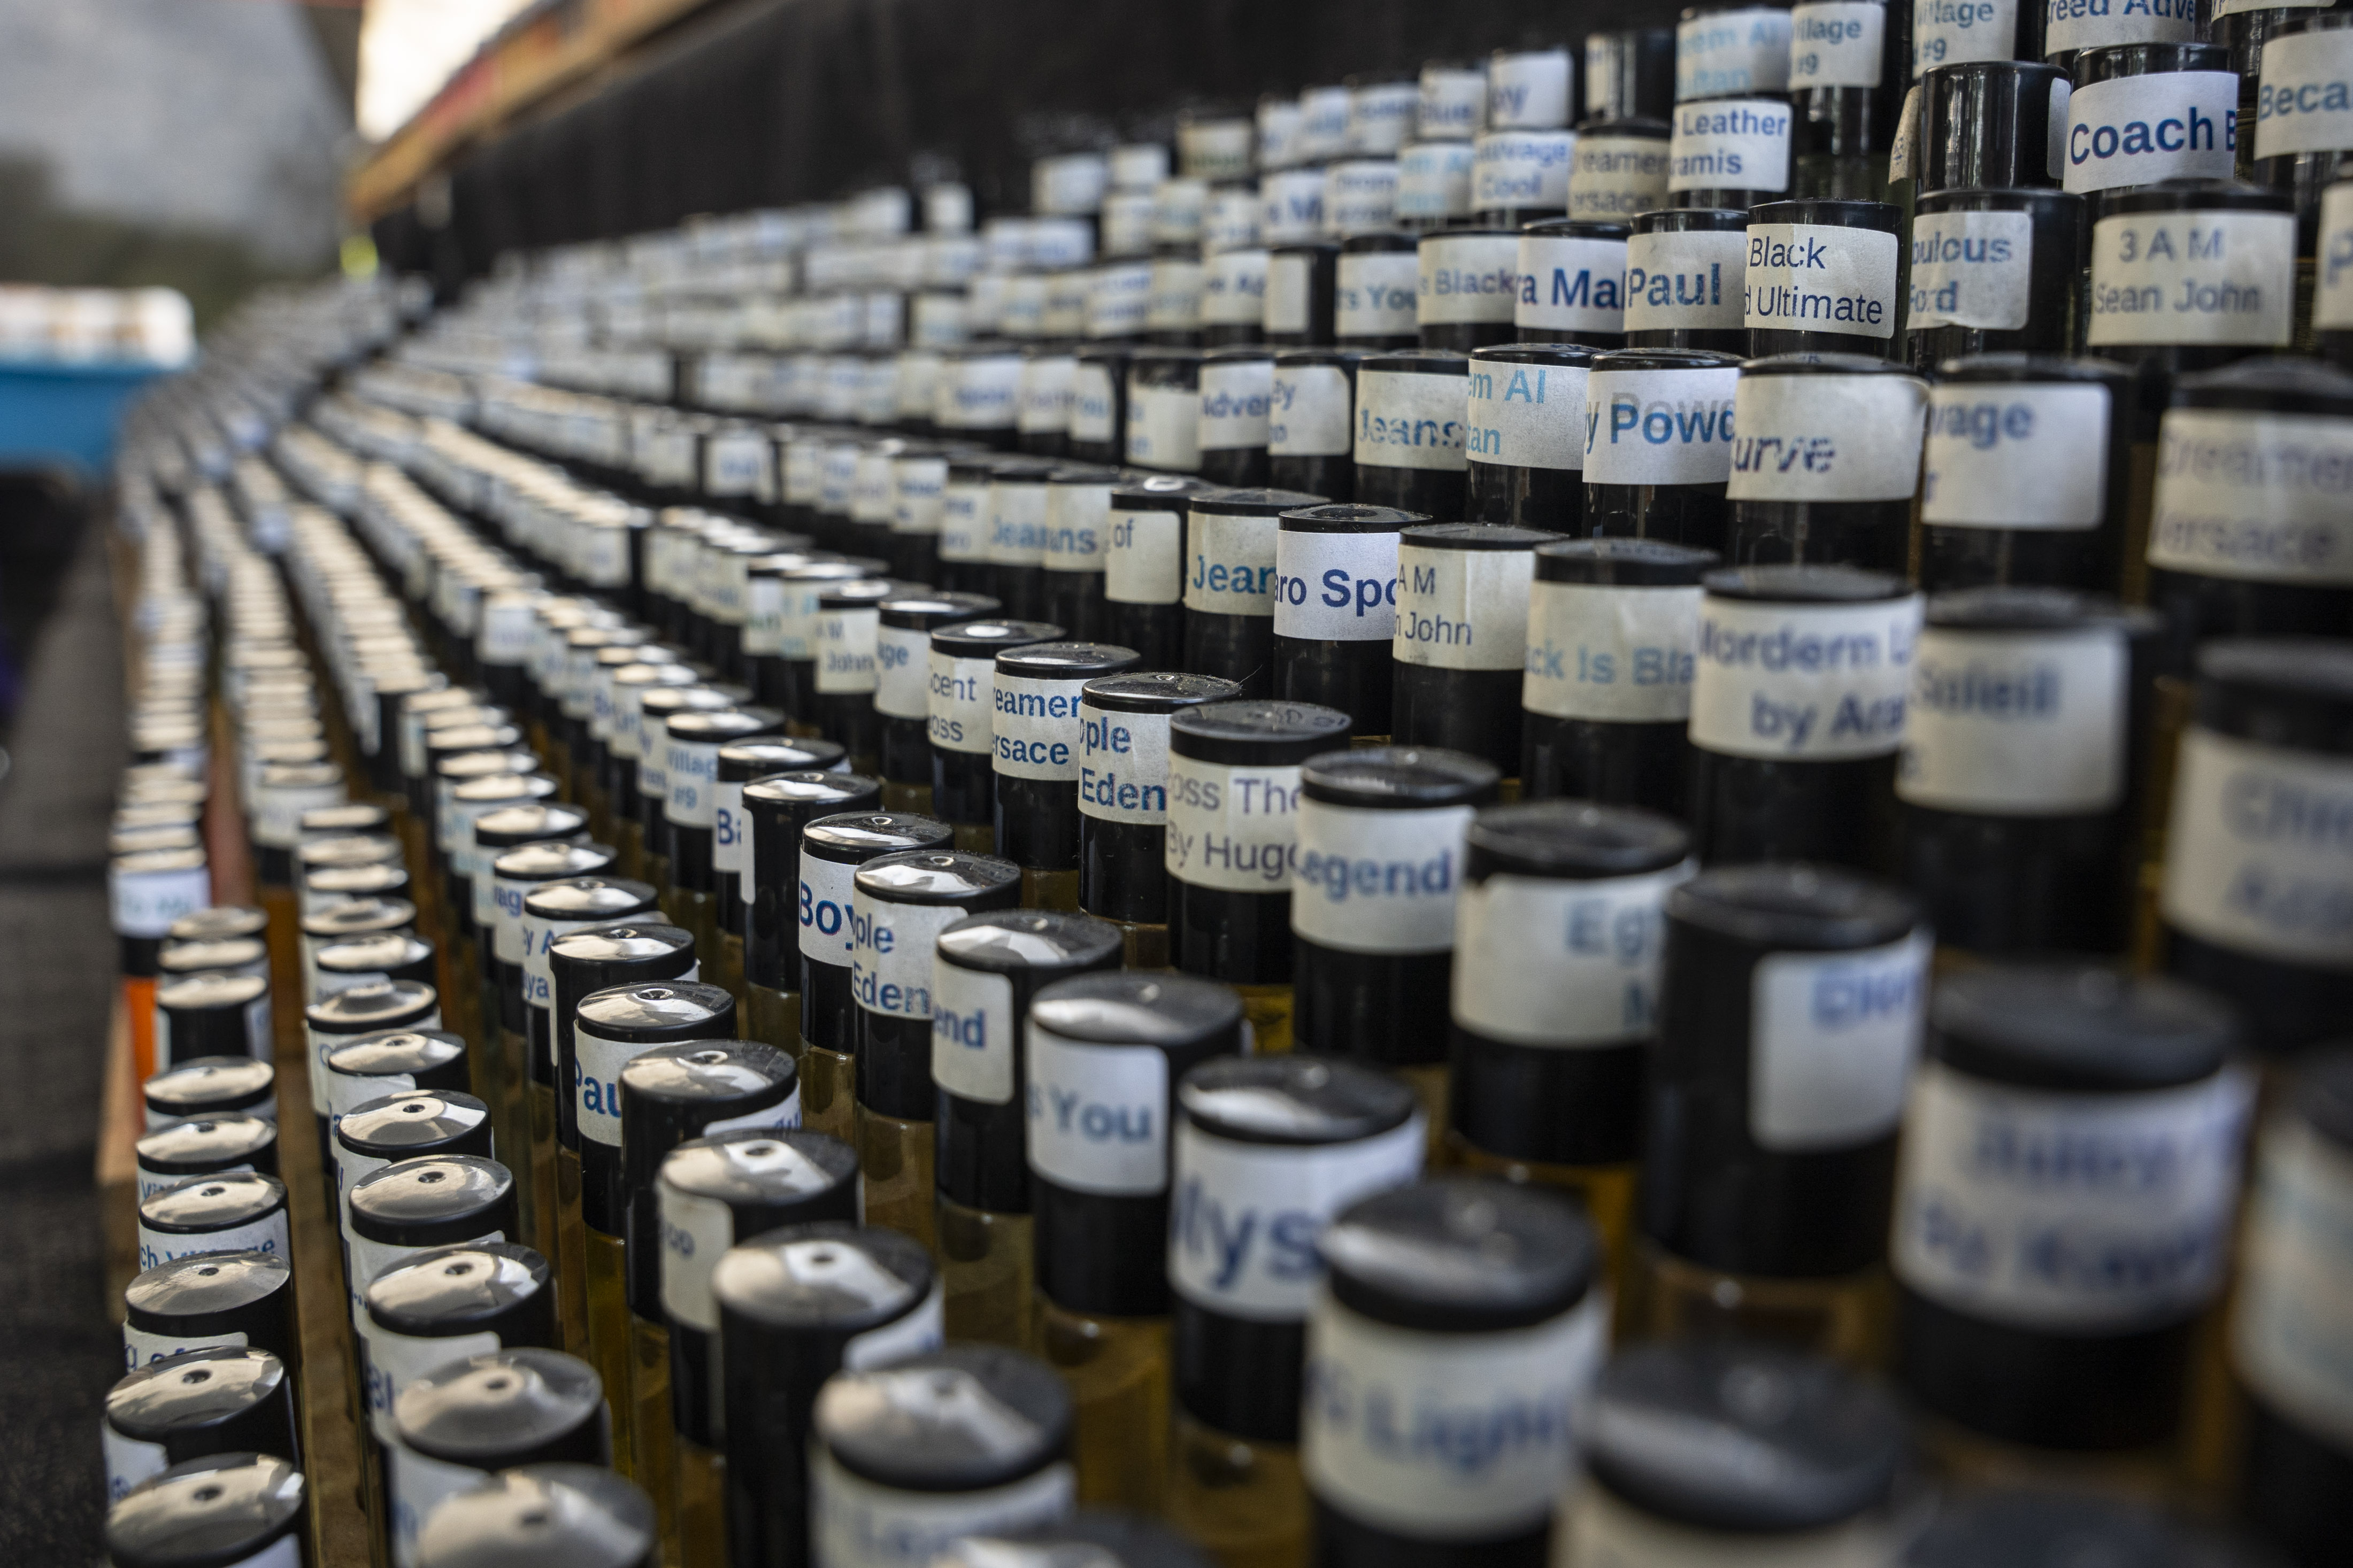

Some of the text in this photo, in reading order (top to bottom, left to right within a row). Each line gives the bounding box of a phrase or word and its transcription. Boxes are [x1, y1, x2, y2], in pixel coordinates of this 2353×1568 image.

[1682, 110, 1787, 136] Leather
[2070, 106, 2213, 166] Coach
[1750, 236, 1827, 269] Black
[2119, 227, 2224, 263] 3 A M
[1628, 264, 1721, 306] Paul
[2094, 278, 2260, 314] Sean John
[1757, 285, 1882, 325] Ultimate
[1585, 401, 1600, 455] y
[1114, 517, 1134, 549] of
[1414, 566, 1436, 595] M
[1404, 612, 1473, 645] John
[931, 672, 978, 702] cent
[1751, 691, 1814, 746] by
[1082, 767, 1167, 812] Eden
[854, 960, 932, 1015] Eden
[1049, 1083, 1152, 1143] You
